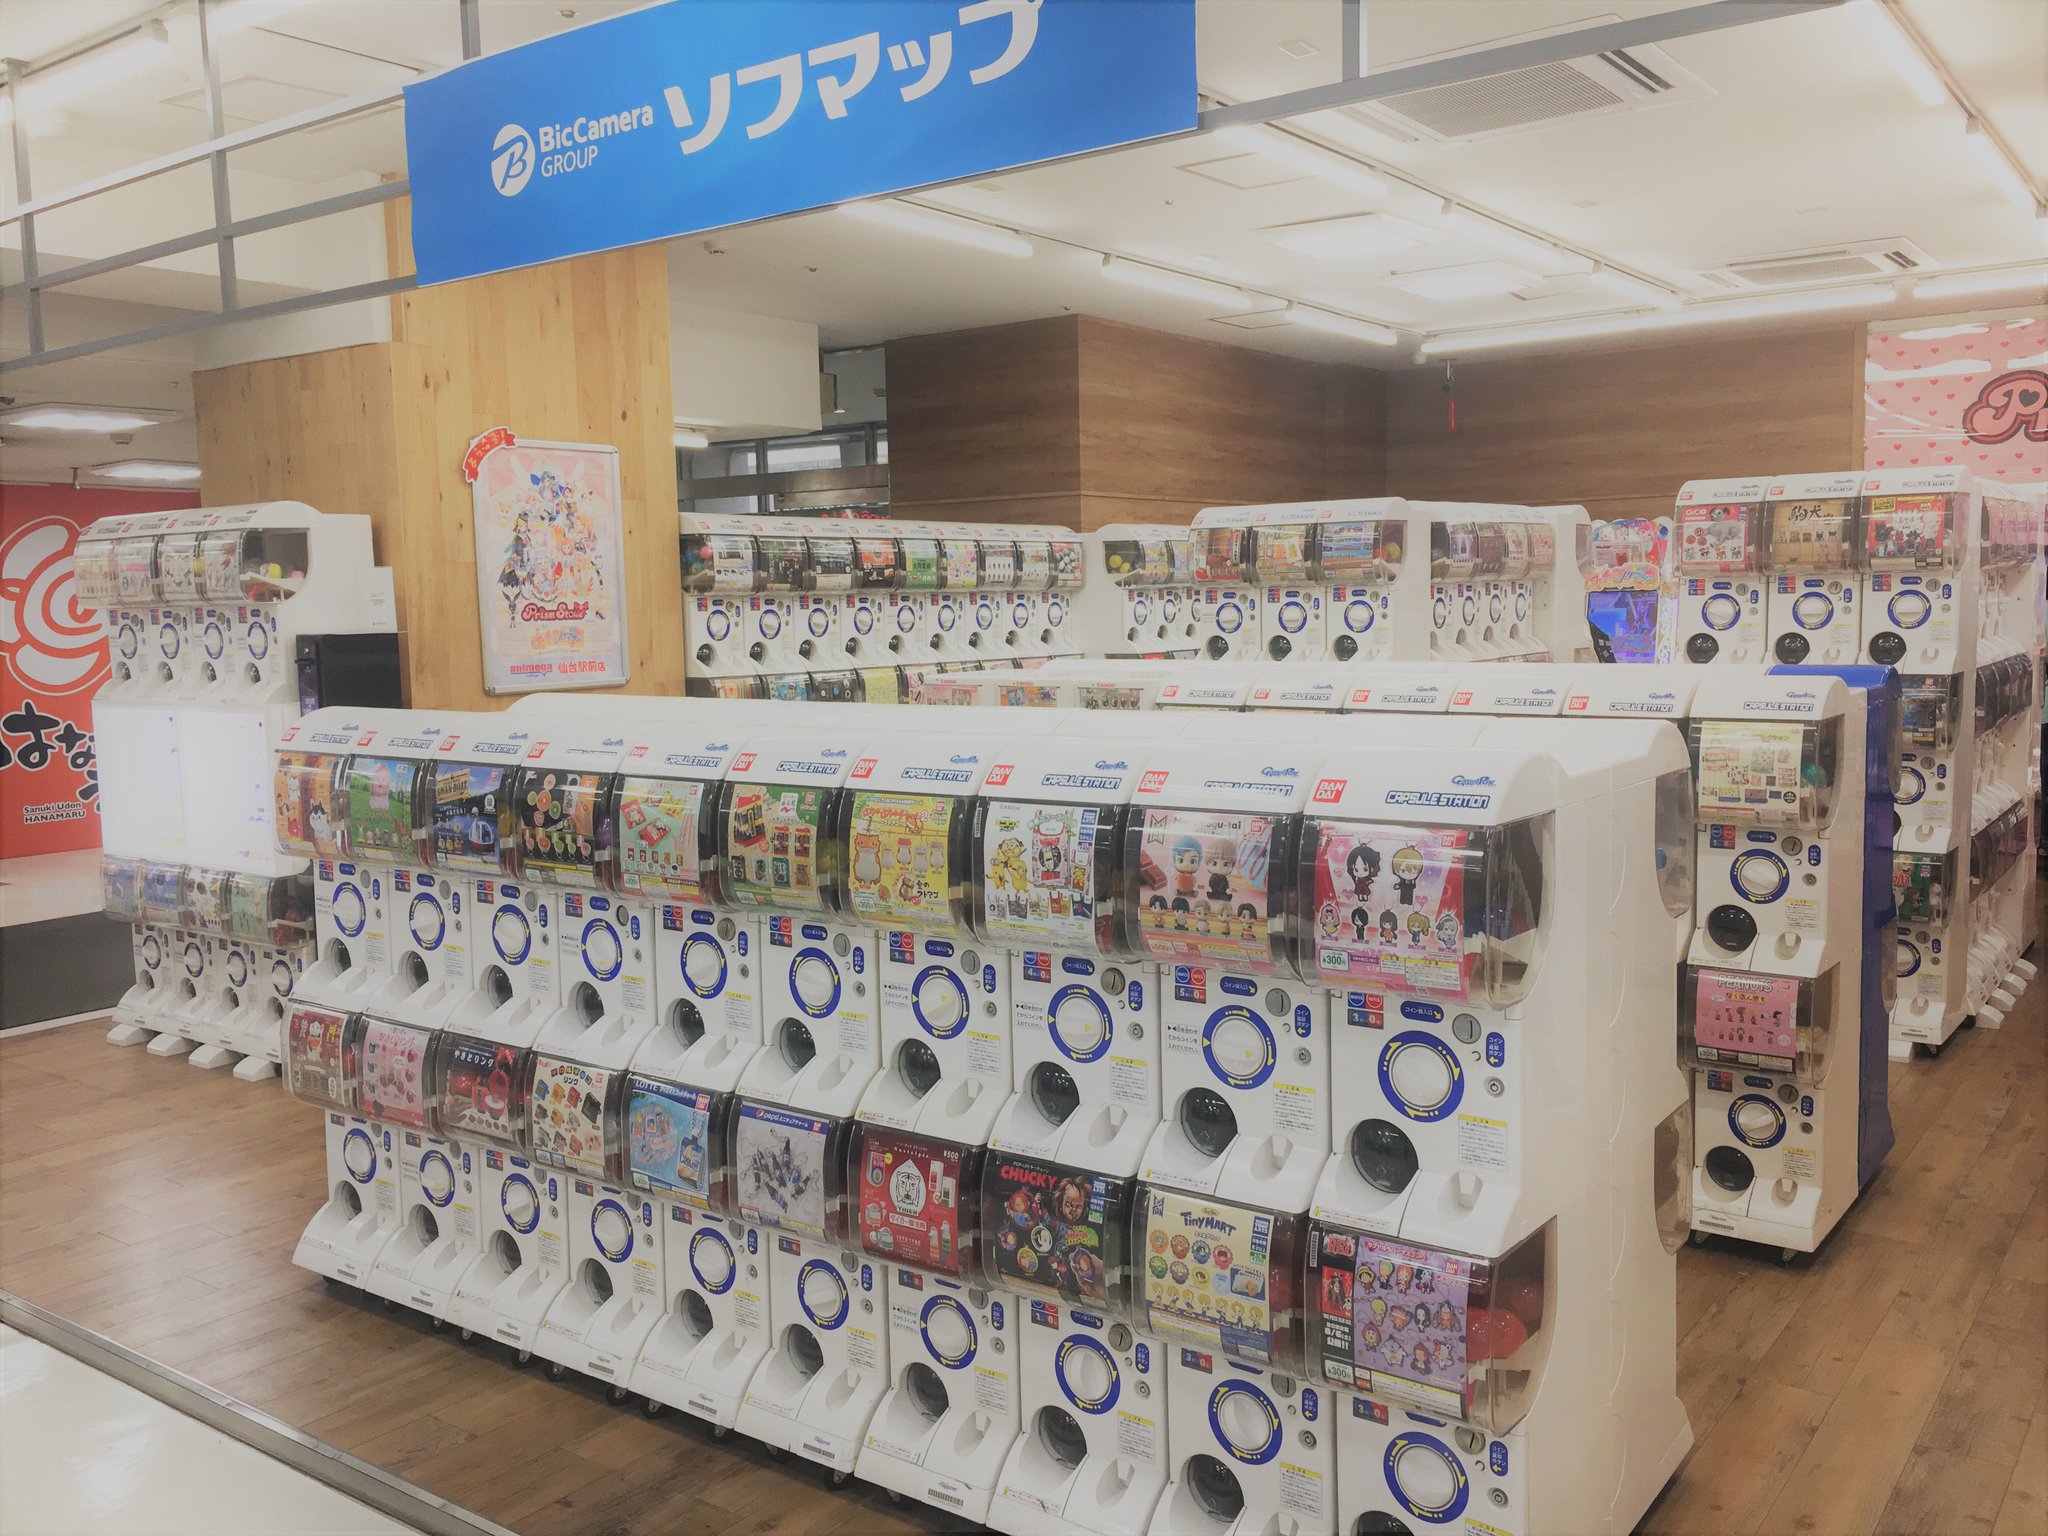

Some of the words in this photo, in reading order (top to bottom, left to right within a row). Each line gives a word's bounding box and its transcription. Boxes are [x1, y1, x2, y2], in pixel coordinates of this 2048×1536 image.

[663, 0, 1043, 156] ソフマップ
[539, 102, 653, 153] BicCamera
[541, 144, 598, 178] GROUP
[558, 660, 606, 674] 仙台駅前店
[857, 760, 876, 769] BAN
[992, 766, 1012, 775] BAN
[851, 769, 869, 777] DAI
[901, 767, 938, 779] CAPSULE
[937, 769, 973, 782] STATION
[1145, 773, 1166, 781] BAN
[986, 775, 1005, 784] DAI
[1041, 774, 1083, 787] CAPSULE
[1082, 776, 1122, 790] STATION
[1319, 782, 1343, 790] BAN
[1315, 791, 1337, 800] DAI
[1385, 791, 1441, 806] CAPSULE
[1441, 794, 1490, 809] STATION
[24, 803, 55, 814] Sanuki
[57, 802, 81, 810] Udon
[25, 810, 86, 823] HANAMARU
[1718, 975, 1773, 993] PEANUTS
[1405, 1007, 1433, 1016] コイン投入口
[635, 1080, 658, 1092] LOTTE
[763, 1112, 780, 1121] pepsi
[1001, 1164, 1057, 1191] CHUCKY
